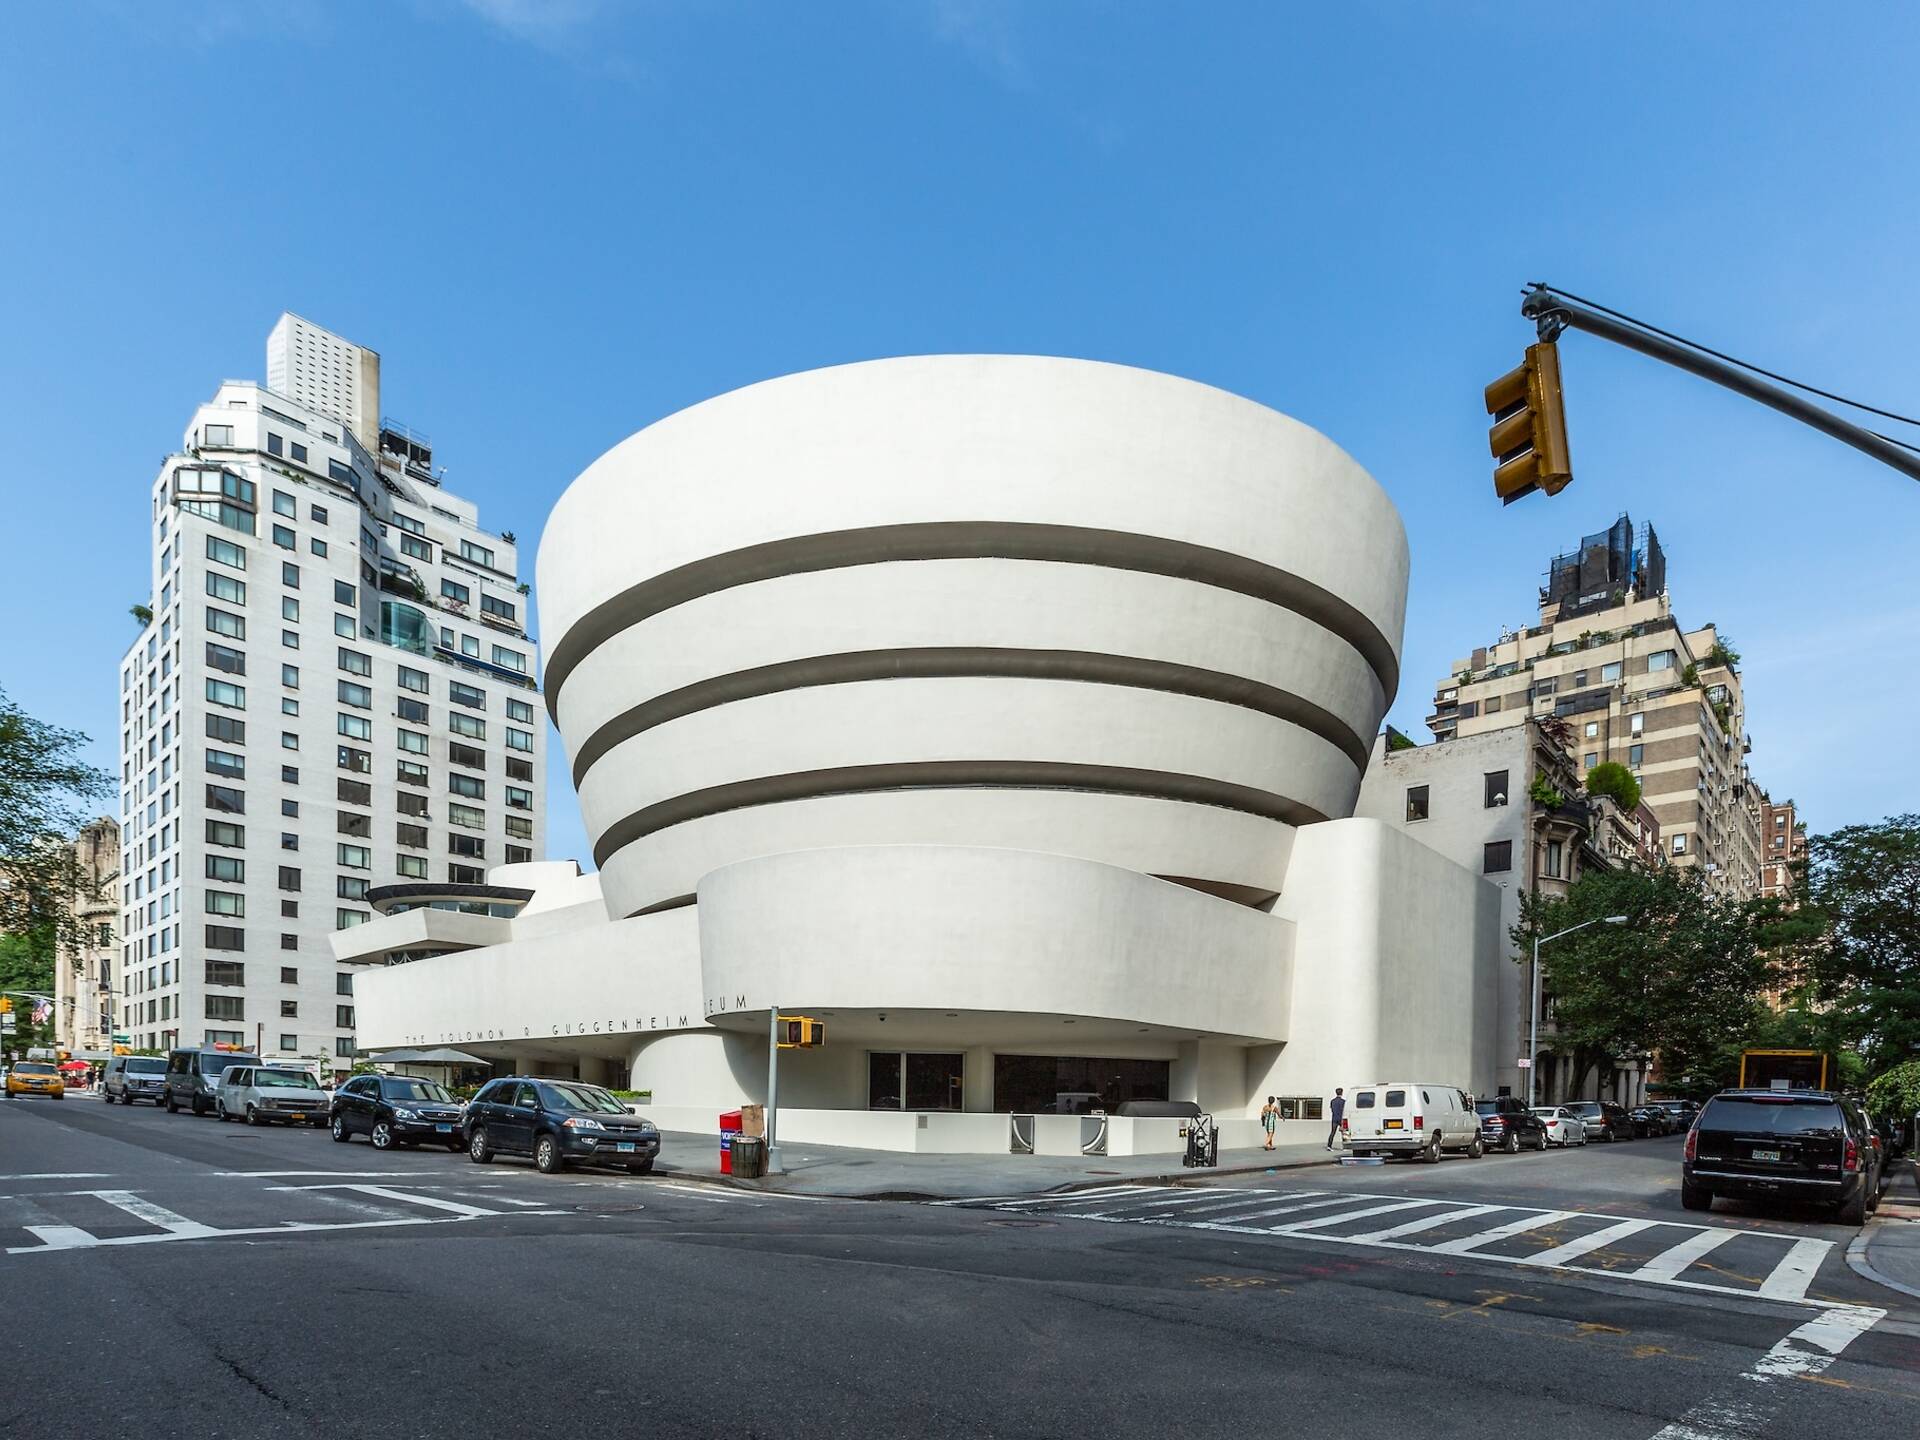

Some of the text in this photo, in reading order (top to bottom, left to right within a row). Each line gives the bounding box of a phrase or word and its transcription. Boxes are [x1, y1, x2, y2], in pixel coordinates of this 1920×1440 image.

[405, 1034, 425, 1044] THE
[440, 1029, 504, 1043] SOLOMON
[552, 1015, 688, 1035] GUGGENHEIM
